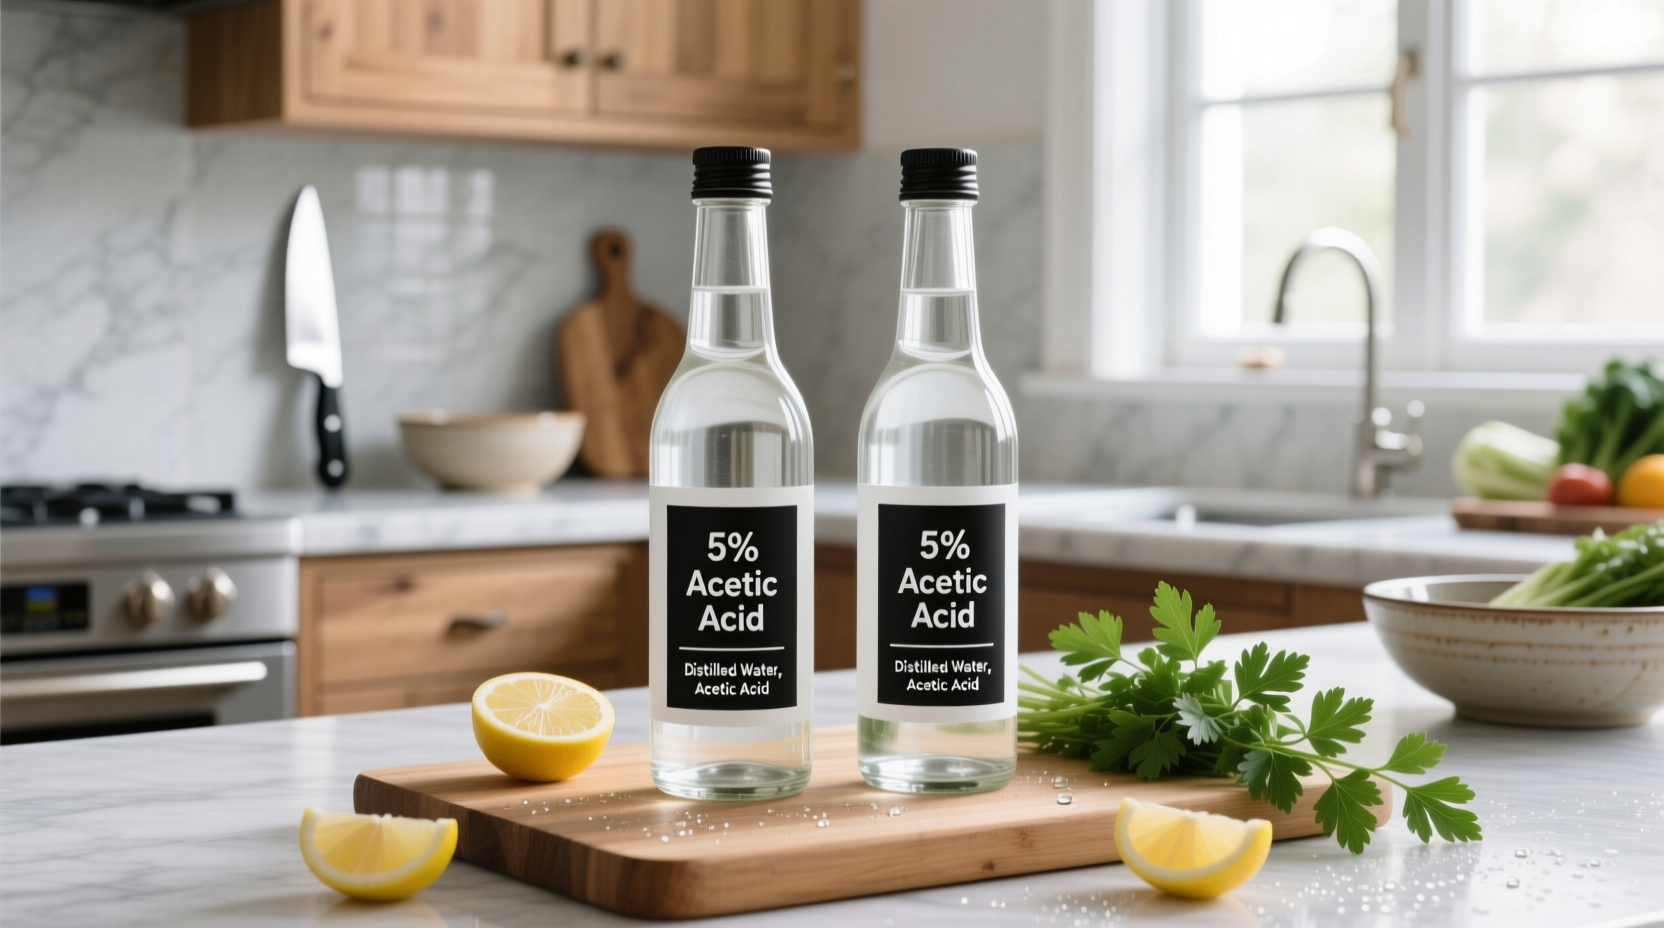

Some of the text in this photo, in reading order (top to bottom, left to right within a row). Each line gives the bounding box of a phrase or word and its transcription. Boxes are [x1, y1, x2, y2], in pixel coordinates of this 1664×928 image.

[707, 531, 759, 562] 5%
[920, 529, 970, 560] 5%
[686, 569, 777, 597] Acetic
[897, 567, 987, 594] Acetic
[698, 603, 764, 631] Acid
[910, 600, 974, 628] Acid
[684, 662, 783, 679] Distilled Water,
[895, 660, 948, 673] Distilled
[695, 680, 770, 695] Acetic Acid
[906, 676, 979, 691] Acetic Acid
